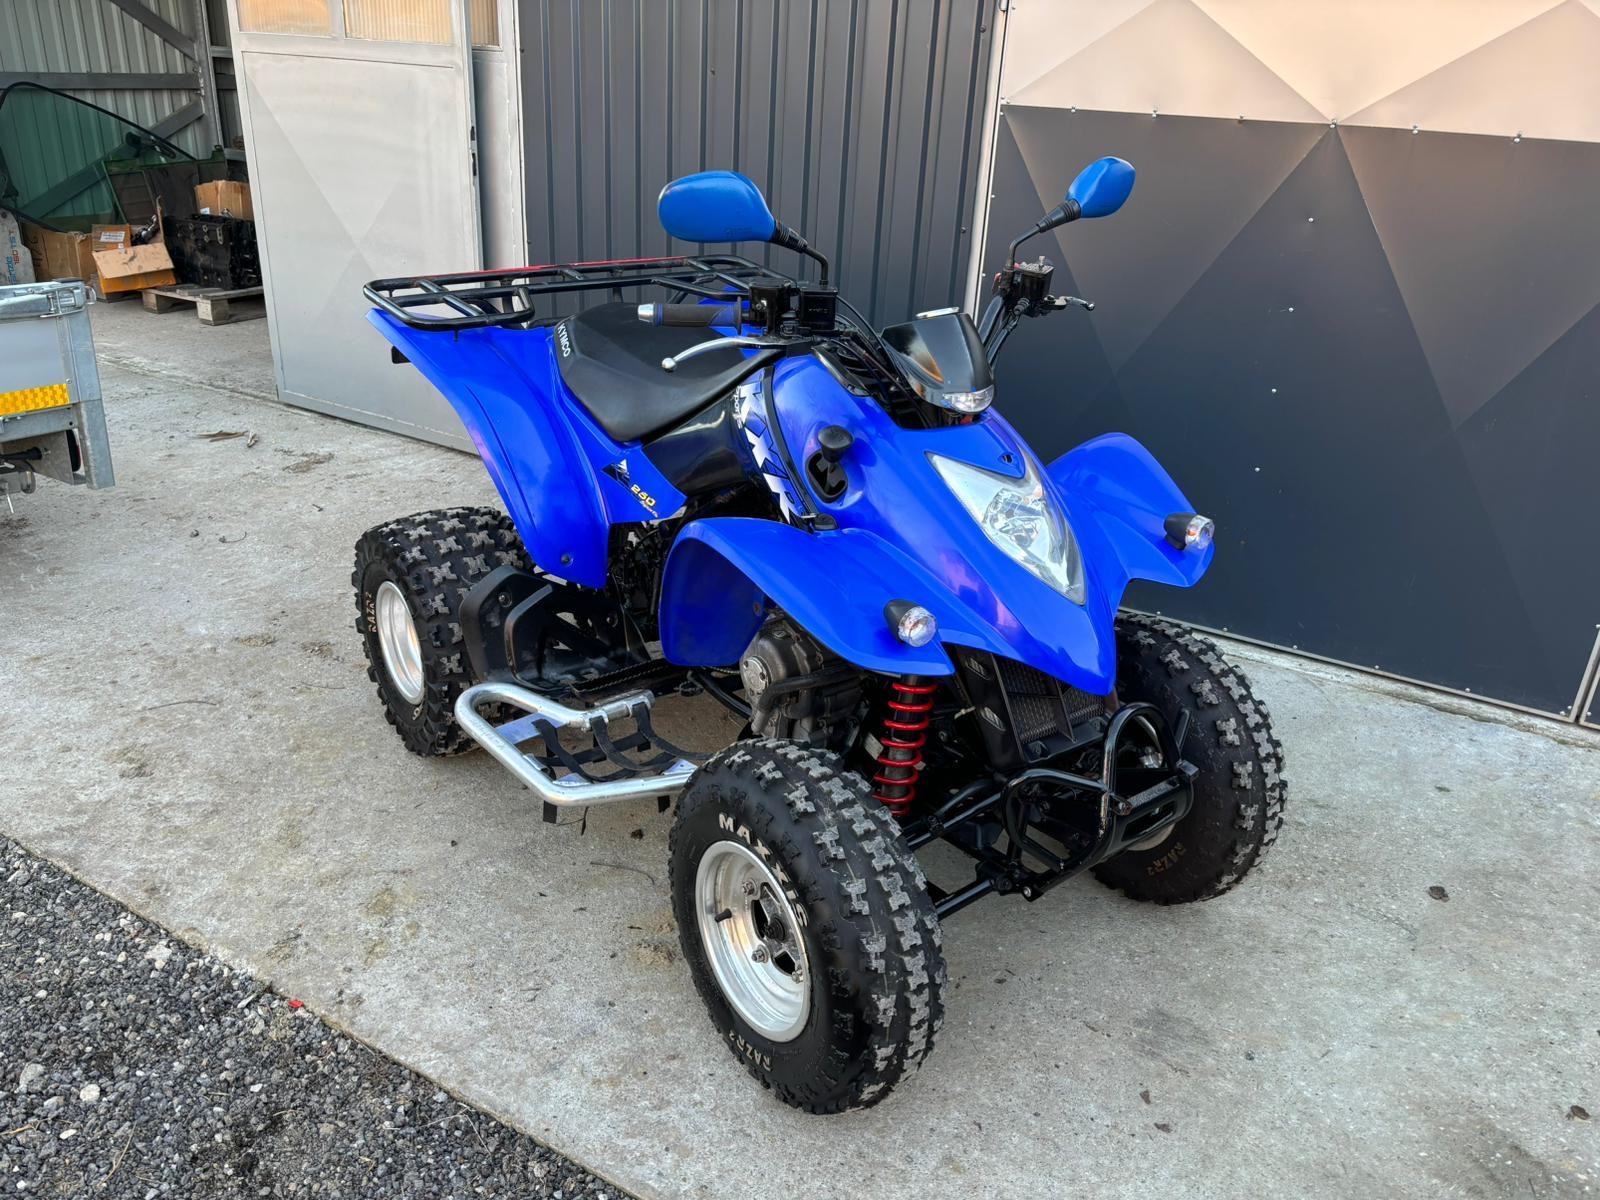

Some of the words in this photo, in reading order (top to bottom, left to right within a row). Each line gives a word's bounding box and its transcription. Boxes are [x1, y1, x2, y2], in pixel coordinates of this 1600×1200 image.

[557, 322, 571, 357] KYMCO
[740, 381, 803, 525] KXR
[719, 813, 808, 928] MAXXIS
[736, 1034, 771, 1072] RAZR
